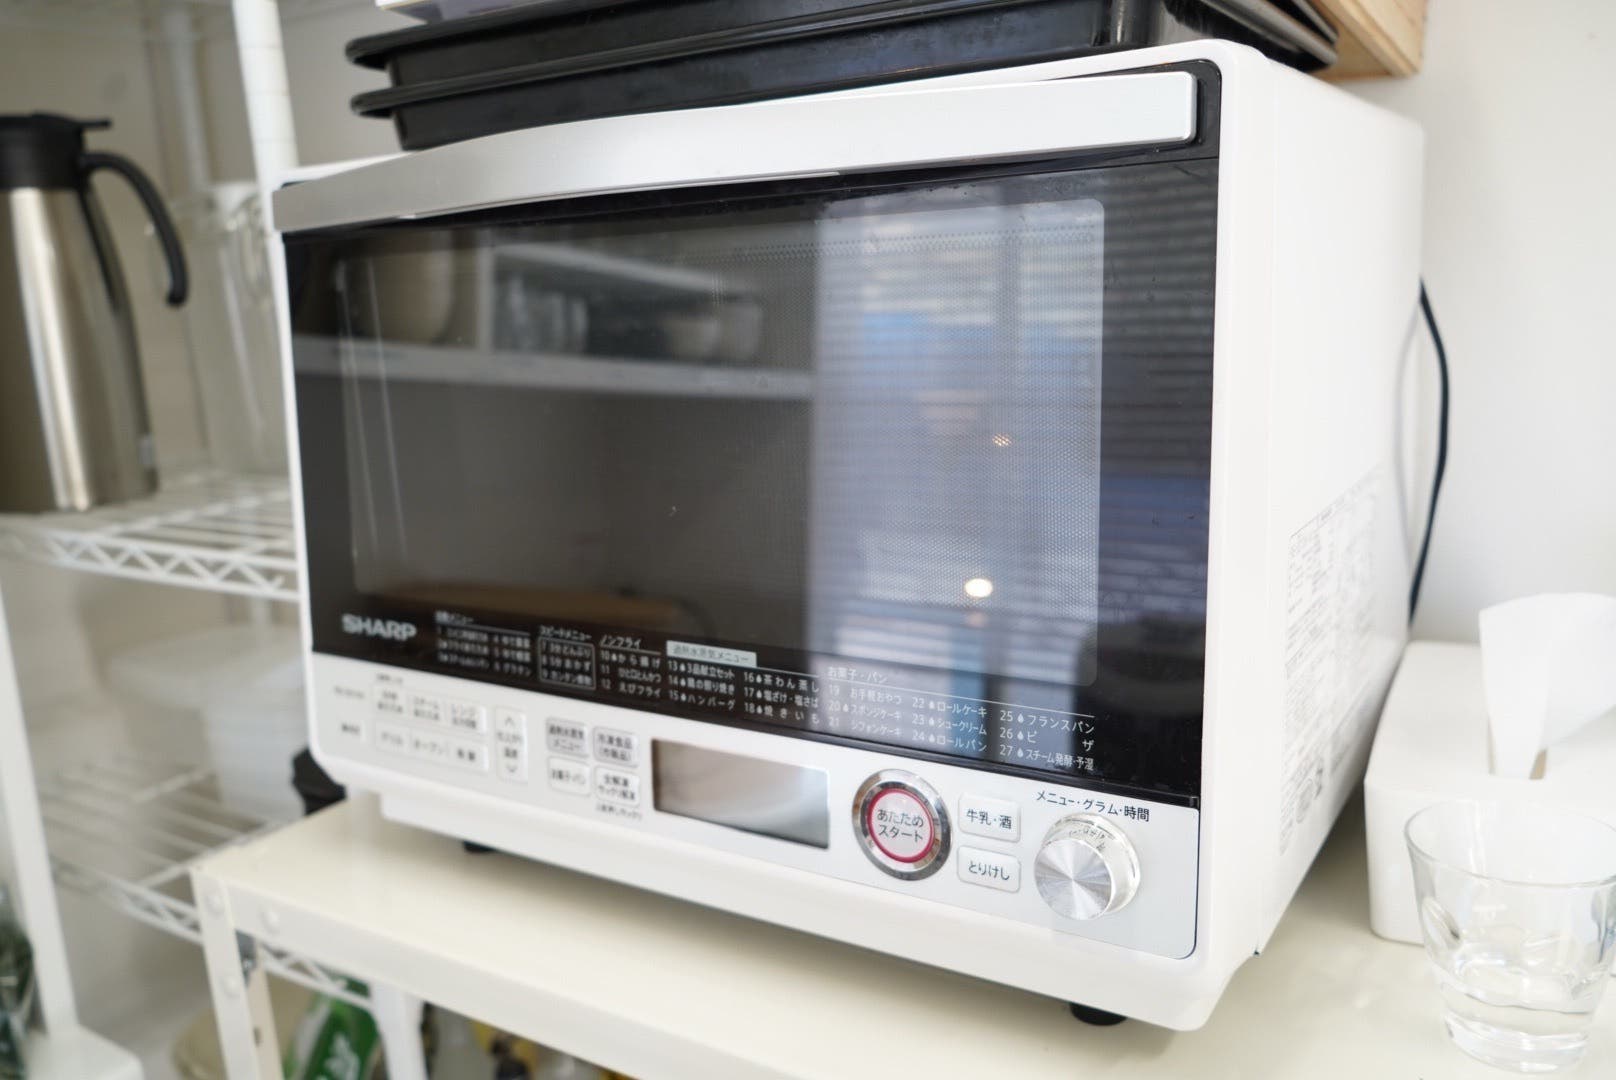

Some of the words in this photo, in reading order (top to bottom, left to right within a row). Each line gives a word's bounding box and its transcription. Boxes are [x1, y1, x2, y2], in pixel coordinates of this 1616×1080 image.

[343, 613, 417, 641] SHARP
[540, 626, 592, 641] スピードメニュー
[600, 634, 643, 650] ノンフライ
[667, 660, 678, 671] 13
[687, 662, 735, 680] 3品献立セット
[668, 674, 678, 686] 14
[827, 666, 888, 684] お菓子・パン
[744, 671, 755, 683] 16
[763, 674, 819, 694] 茶わん蒸し
[744, 686, 755, 698] 17
[669, 689, 679, 702] 15
[688, 693, 736, 711] ハンバーグ
[829, 684, 840, 697] 19
[849, 688, 902, 705] お手軽おやつ
[744, 701, 756, 714] 18
[763, 704, 819, 725] 焼きいも
[829, 701, 841, 713] 20
[850, 704, 902, 721] スポンジケーキ
[911, 697, 925, 709] 22
[937, 701, 987, 719] ロールケーキ
[829, 716, 840, 729] 21
[850, 719, 904, 738] シフォンケーキ
[911, 713, 925, 726] 23
[937, 718, 987, 735] シュークリーム
[1000, 709, 1014, 722] 25
[1027, 714, 1095, 734] フランスパン
[911, 729, 925, 742] 24
[936, 733, 987, 752] ロールパン
[1000, 726, 1014, 740] 26
[1000, 743, 1015, 757] 27
[1036, 790, 1150, 822] メニュー・グラム・時間
[876, 808, 924, 828] あたため
[966, 808, 1012, 830] 牛乳・酒
[878, 823, 924, 843] スタート
[967, 861, 1010, 881] とりけし
